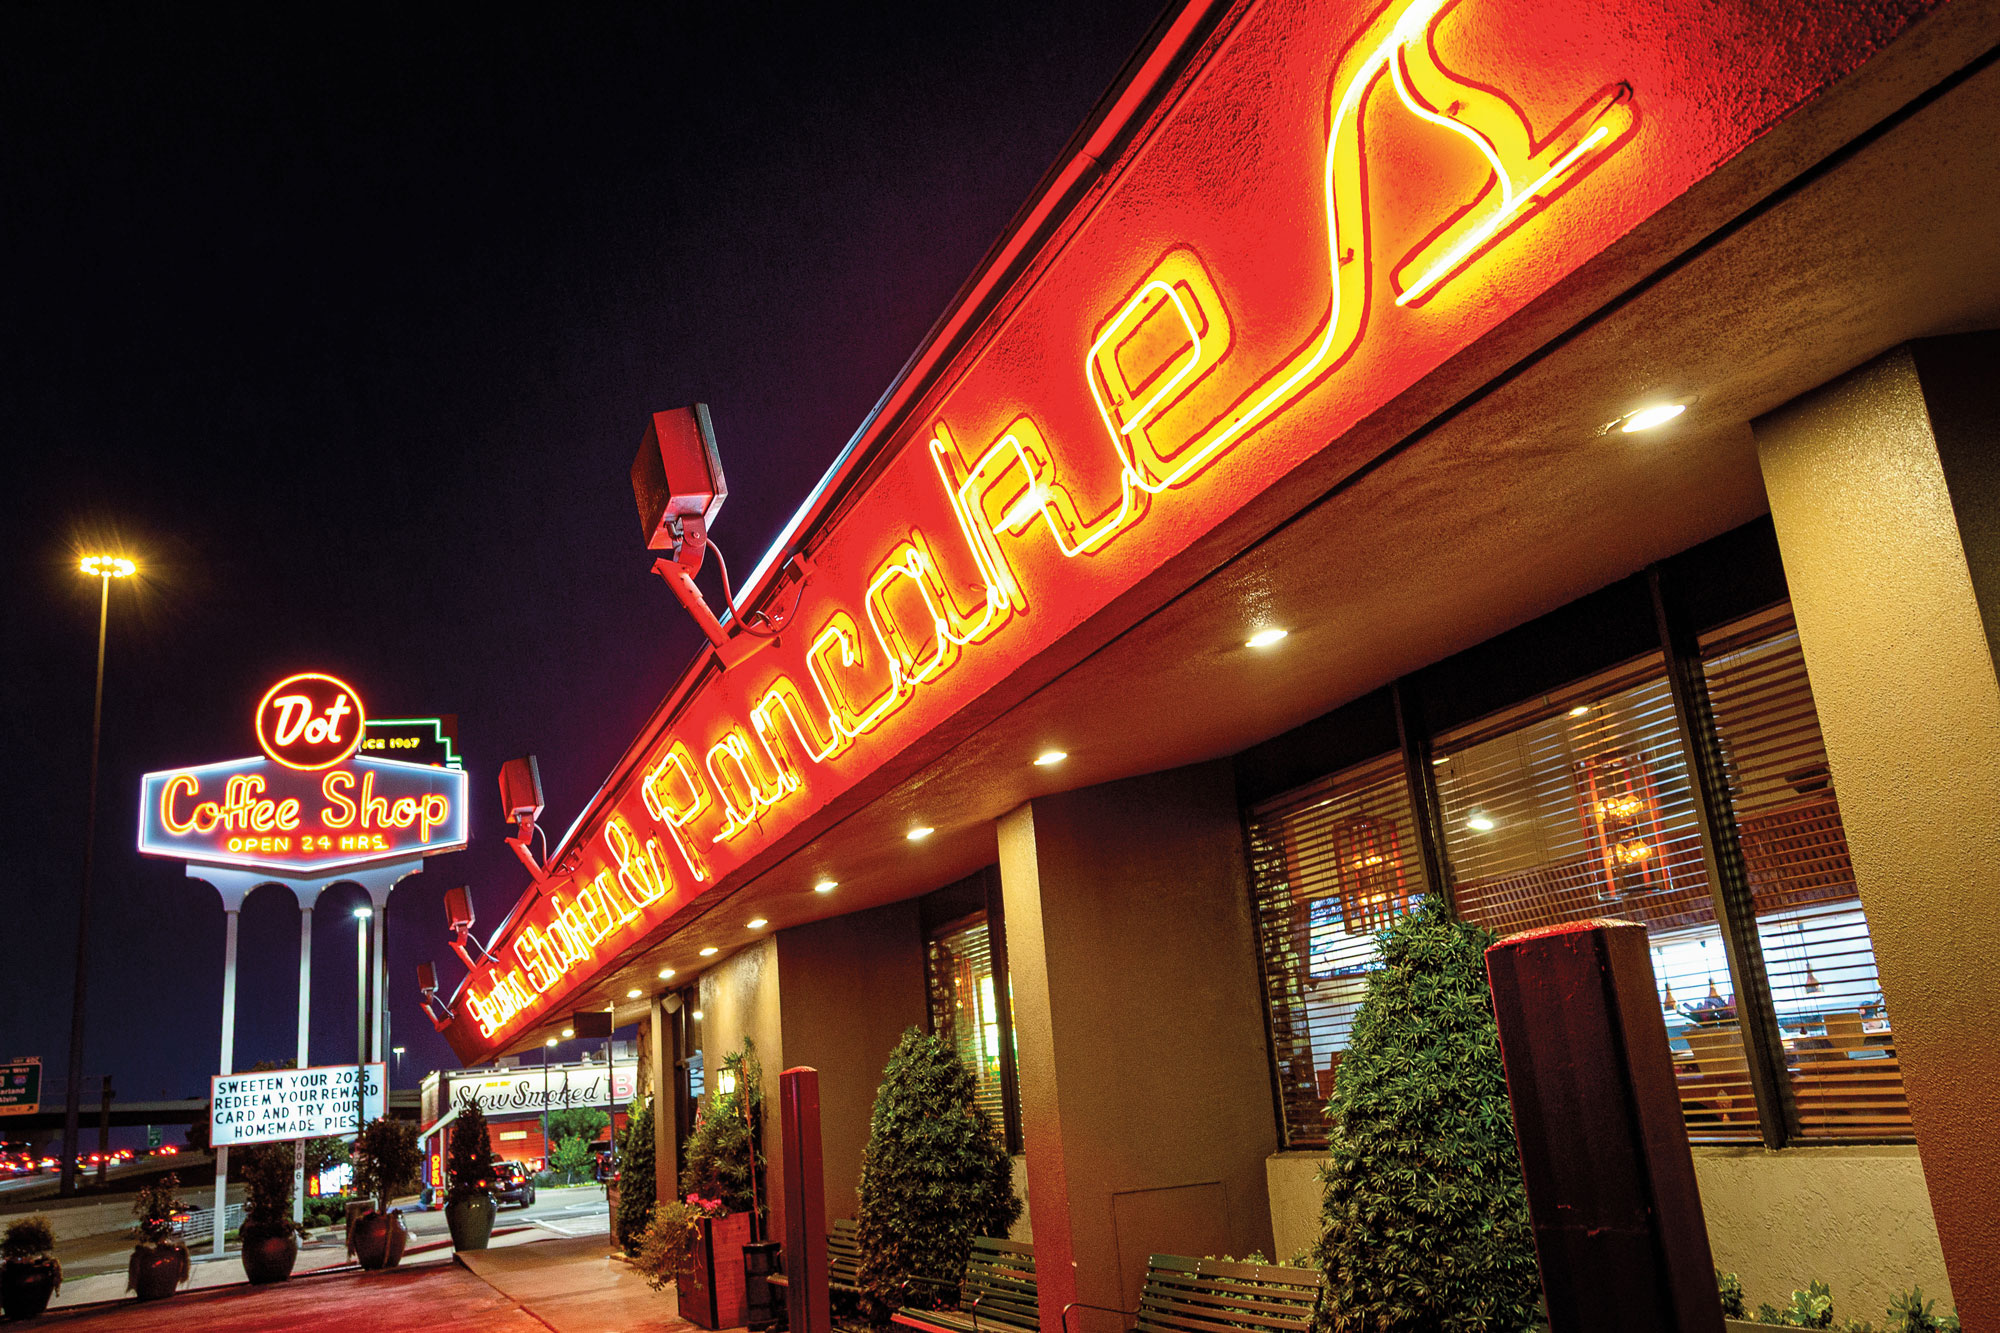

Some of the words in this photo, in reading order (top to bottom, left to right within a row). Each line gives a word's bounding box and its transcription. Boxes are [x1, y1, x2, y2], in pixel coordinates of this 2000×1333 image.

[513, 871, 643, 993] Shakes
[603, 814, 674, 910] &
[640, 0, 1642, 883] Pancakes
[272, 694, 352, 747] Dot
[160, 773, 301, 836] Coffee
[321, 770, 449, 843] Shop
[228, 836, 289, 852] OPEN
[301, 835, 331, 851] 24
[214, 1093, 271, 1111] REDEEM
[279, 1089, 317, 1103] YOUR
[321, 1084, 378, 1101] REWARD
[218, 1077, 283, 1095] SWEETEN
[290, 1074, 328, 1088] YOUR
[450, 1084, 511, 1111] Slow
[510, 1080, 600, 1108] Smoked
[214, 1110, 255, 1125] CARD
[263, 1106, 290, 1120] AND
[297, 1103, 325, 1117] TRY
[332, 1100, 360, 1114] OUR
[234, 1119, 315, 1139] HOMEMADE
[324, 1114, 358, 1130] PIES
